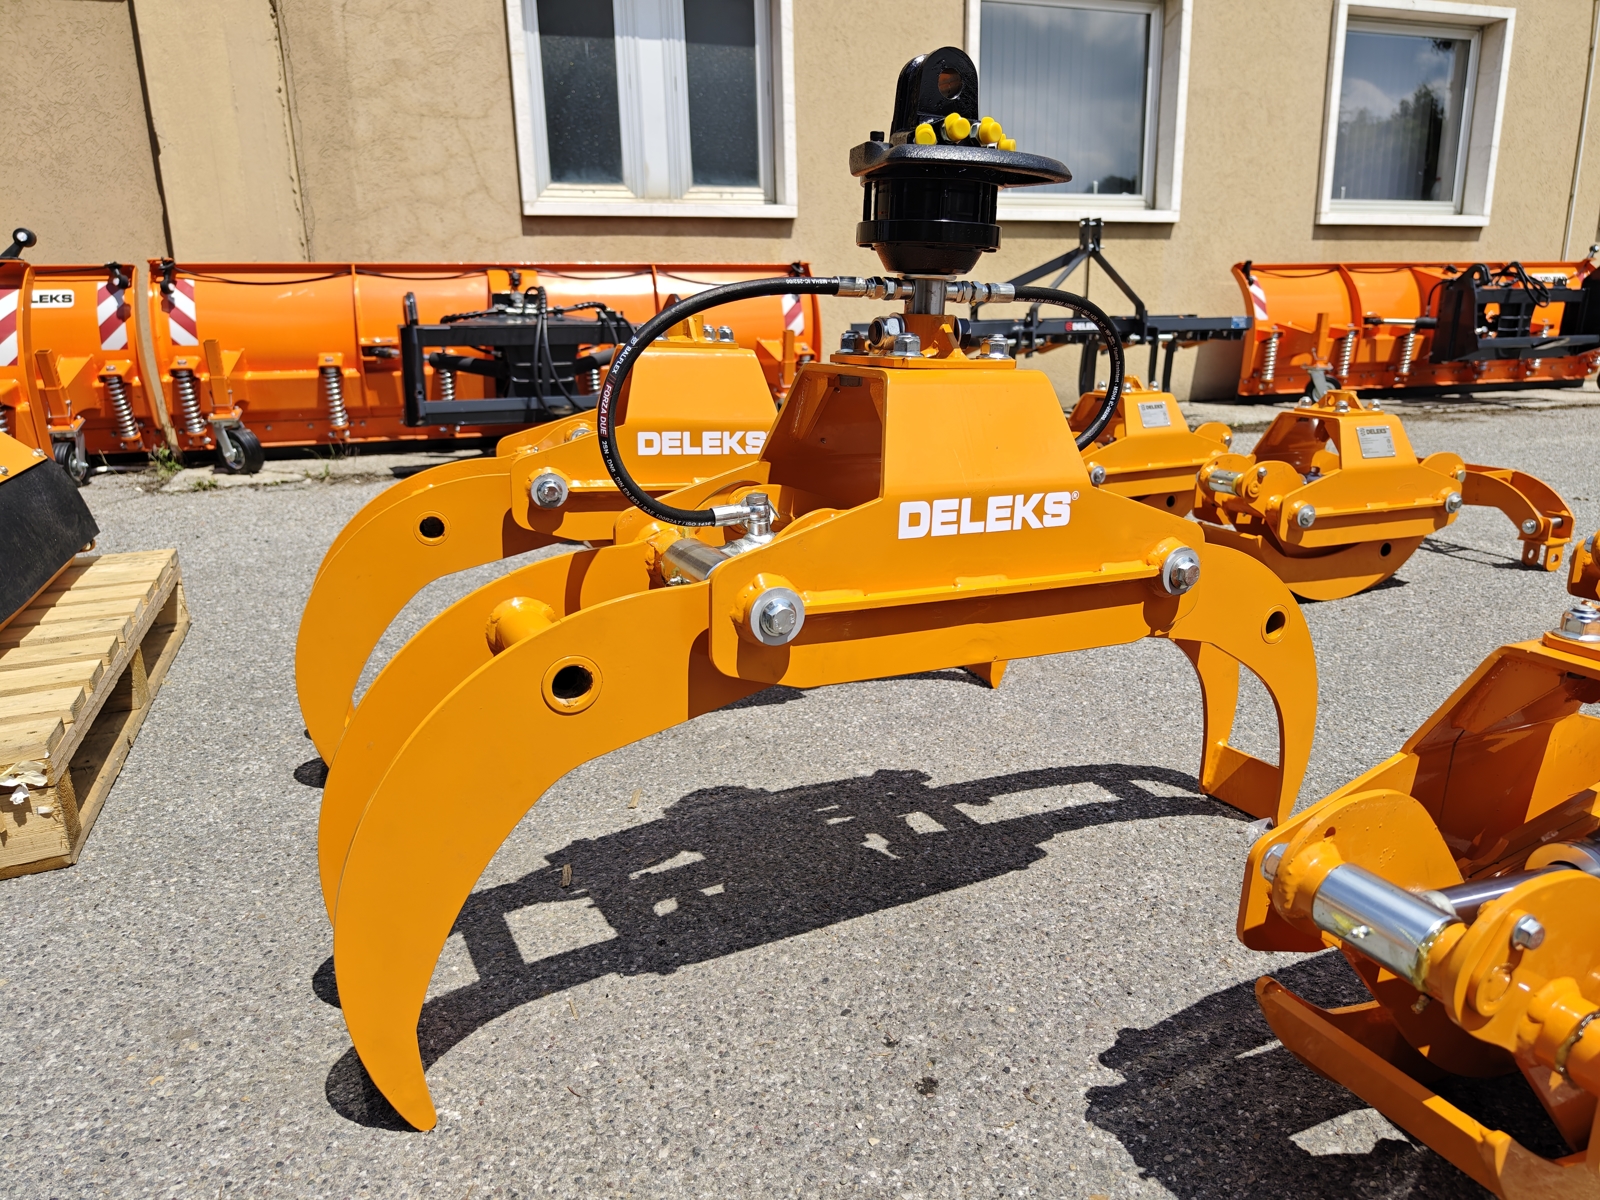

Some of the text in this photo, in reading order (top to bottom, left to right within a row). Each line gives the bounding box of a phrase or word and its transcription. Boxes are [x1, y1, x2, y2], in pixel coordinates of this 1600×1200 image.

[612, 345, 632, 374] BALFLEX
[601, 384, 612, 414] FORZA
[637, 431, 768, 456] DELEKS
